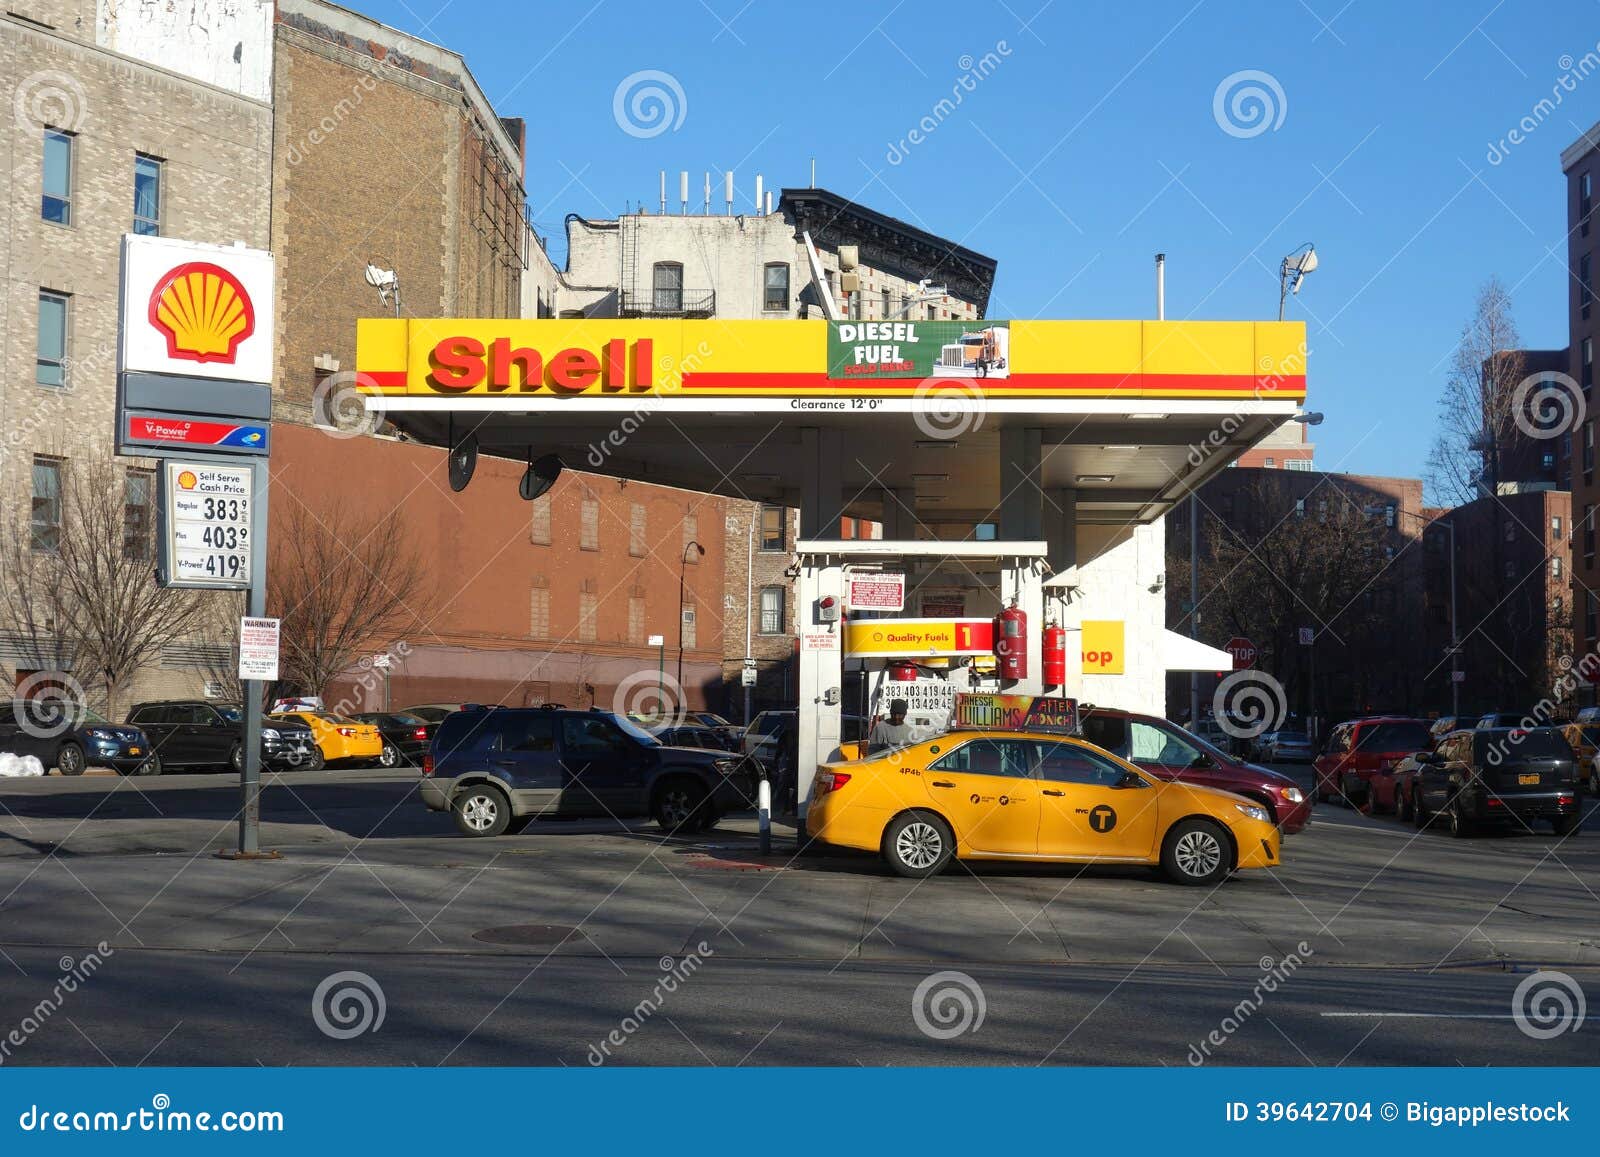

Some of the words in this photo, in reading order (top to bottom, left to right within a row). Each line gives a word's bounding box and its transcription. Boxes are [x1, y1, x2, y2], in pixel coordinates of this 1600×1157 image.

[839, 322, 920, 343] DIESEL
[853, 344, 904, 365] FUEL
[426, 336, 653, 397] Shell
[790, 398, 846, 410] Clearance
[145, 424, 189, 437] V-Power
[200, 472, 215, 481] Self
[217, 473, 240, 483] Serve
[200, 483, 221, 492] Cash
[223, 485, 245, 494] Price
[204, 497, 238, 521] 383
[203, 526, 237, 549] 403
[177, 560, 203, 569] V-Power
[206, 554, 239, 578] 419
[244, 619, 277, 629] WARNING
[887, 633, 922, 644] Quality
[925, 633, 950, 642] Fuels
[961, 627, 971, 647] 1
[1081, 651, 1113, 667] op
[1226, 647, 1255, 660] STOP
[885, 685, 901, 697] 383
[904, 685, 920, 697] 403
[922, 685, 938, 697] 419
[922, 698, 938, 709] 429
[1037, 699, 1074, 713] AFTER
[959, 705, 1021, 727] WILLIAMS
[1095, 809, 1112, 830] T
